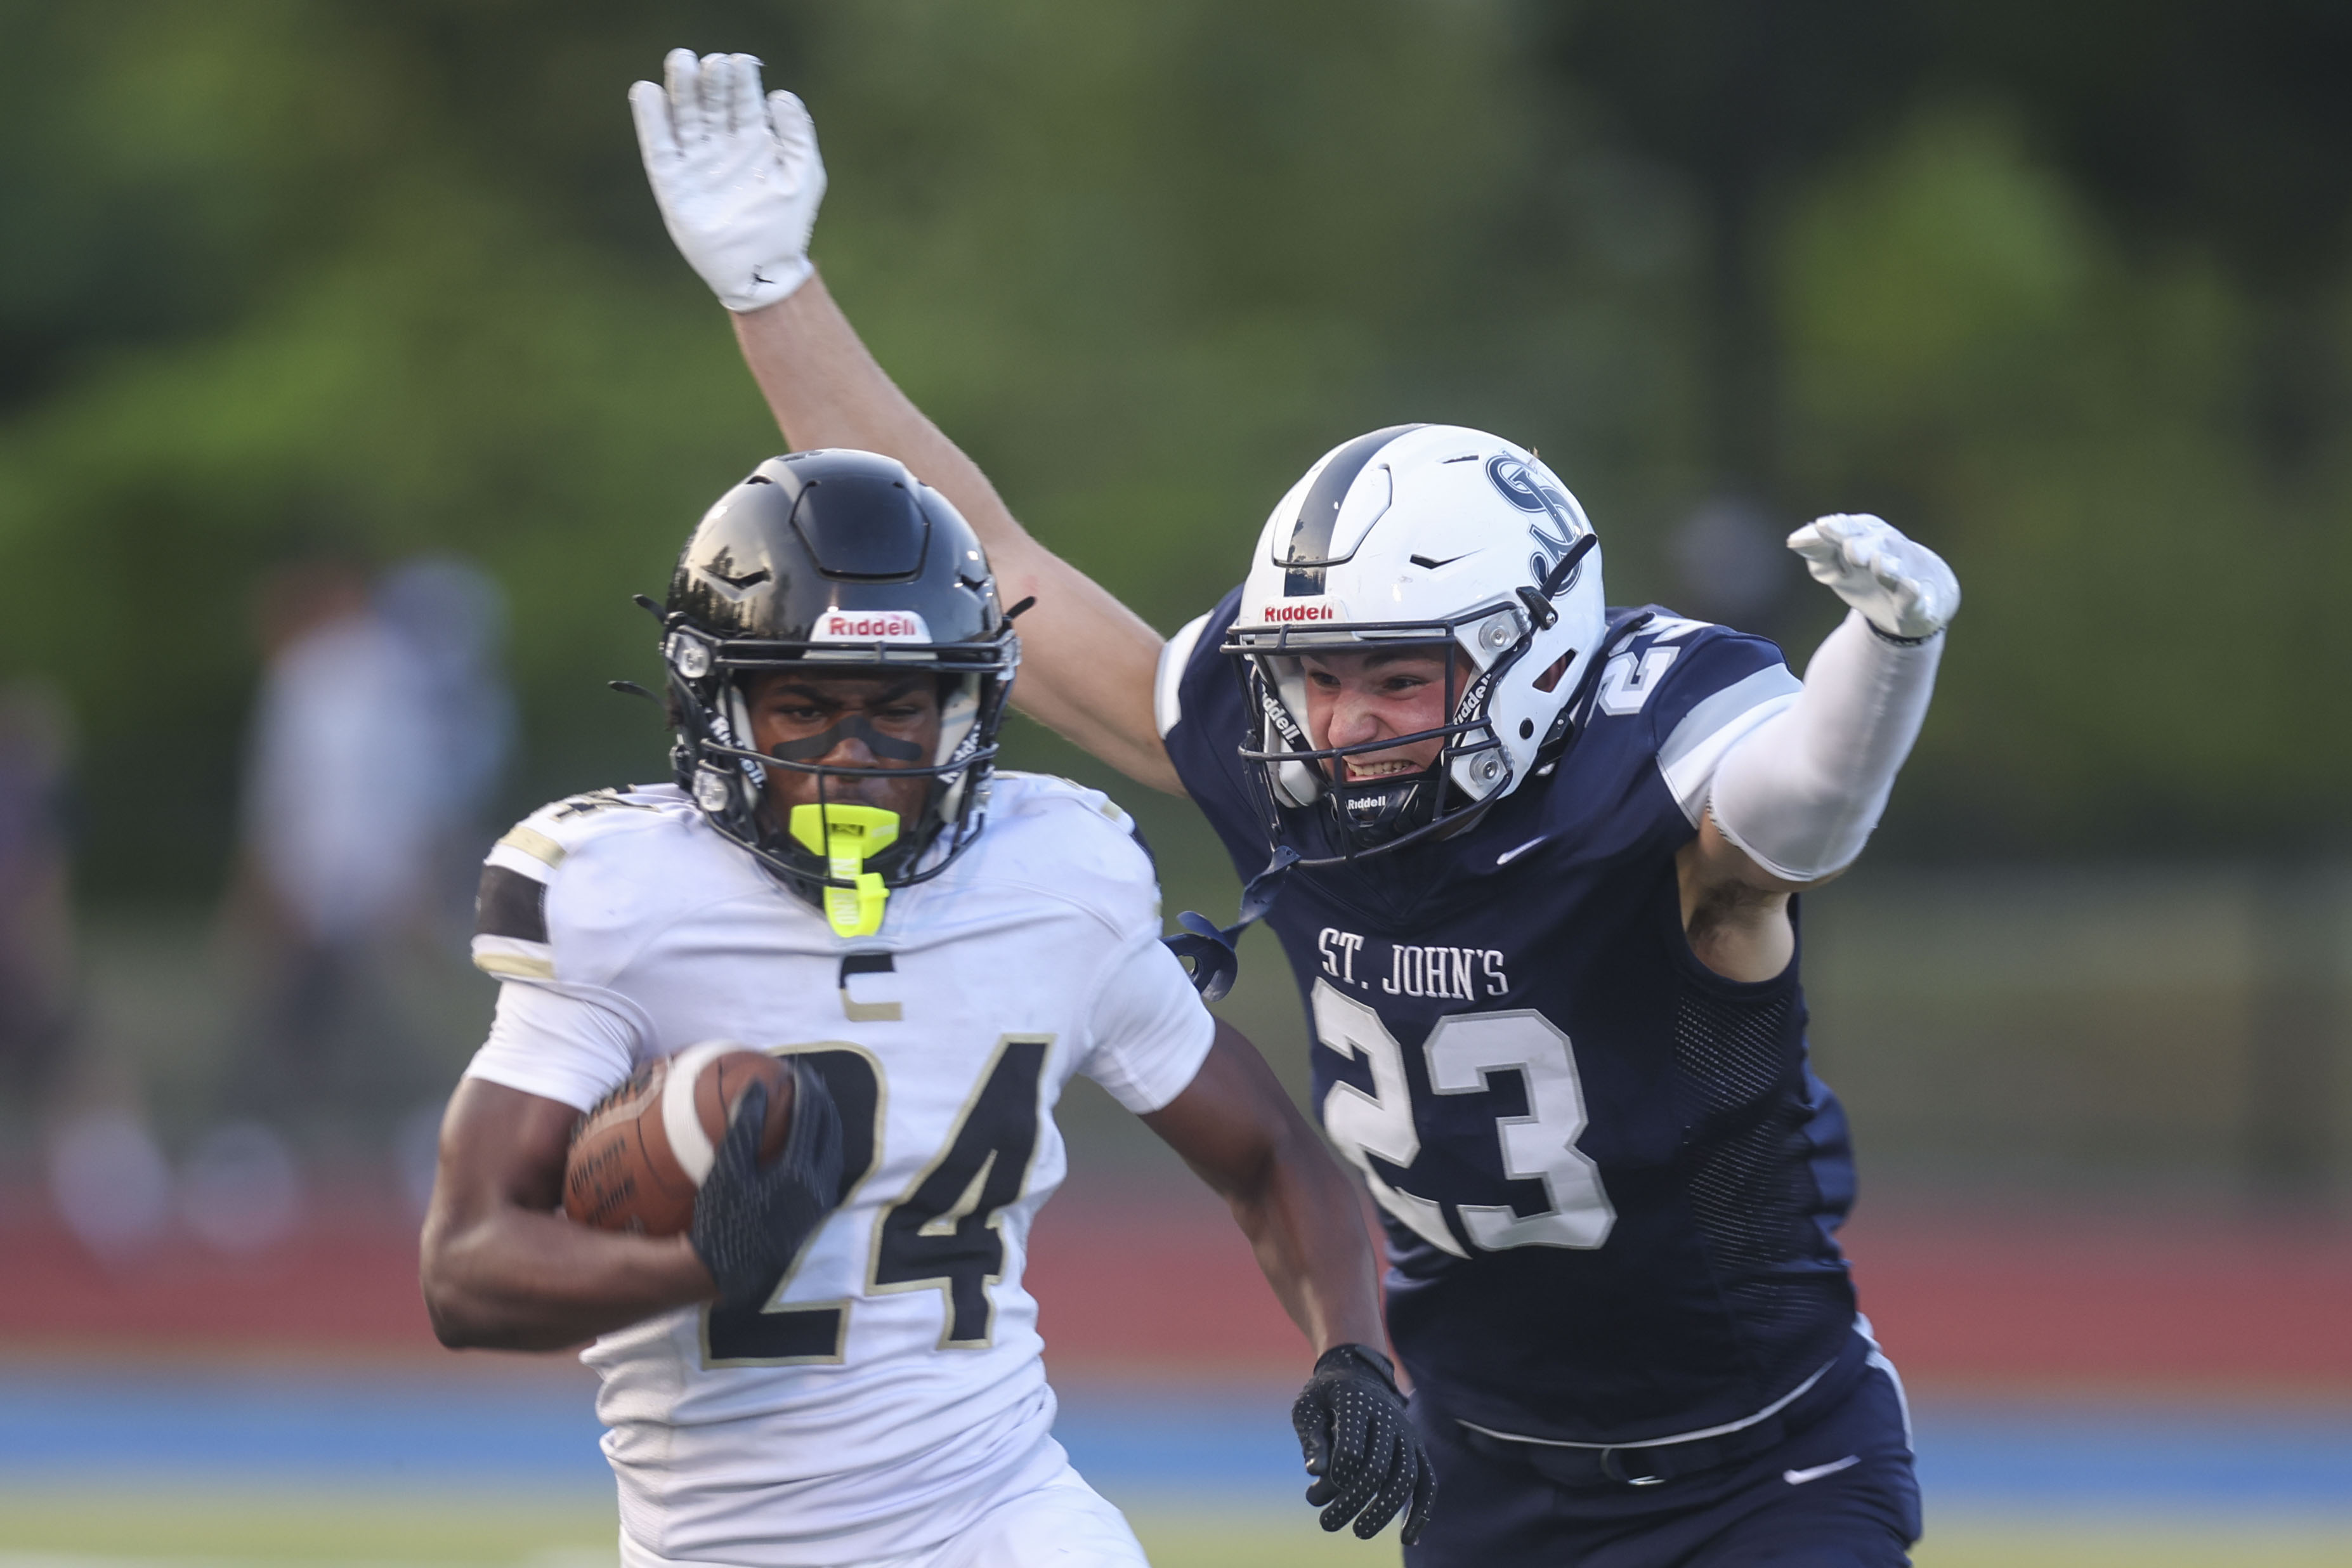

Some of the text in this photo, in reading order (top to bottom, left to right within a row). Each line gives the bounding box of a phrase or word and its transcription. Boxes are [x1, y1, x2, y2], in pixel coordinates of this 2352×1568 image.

[830, 617, 916, 636] Riddell
[1264, 604, 1333, 622] Riddell
[1347, 795, 1387, 810] Riddell
[1317, 927, 1510, 1002] ST. JOHN'S
[1310, 976, 1618, 1260] 23
[700, 1032, 1057, 1371] 24
